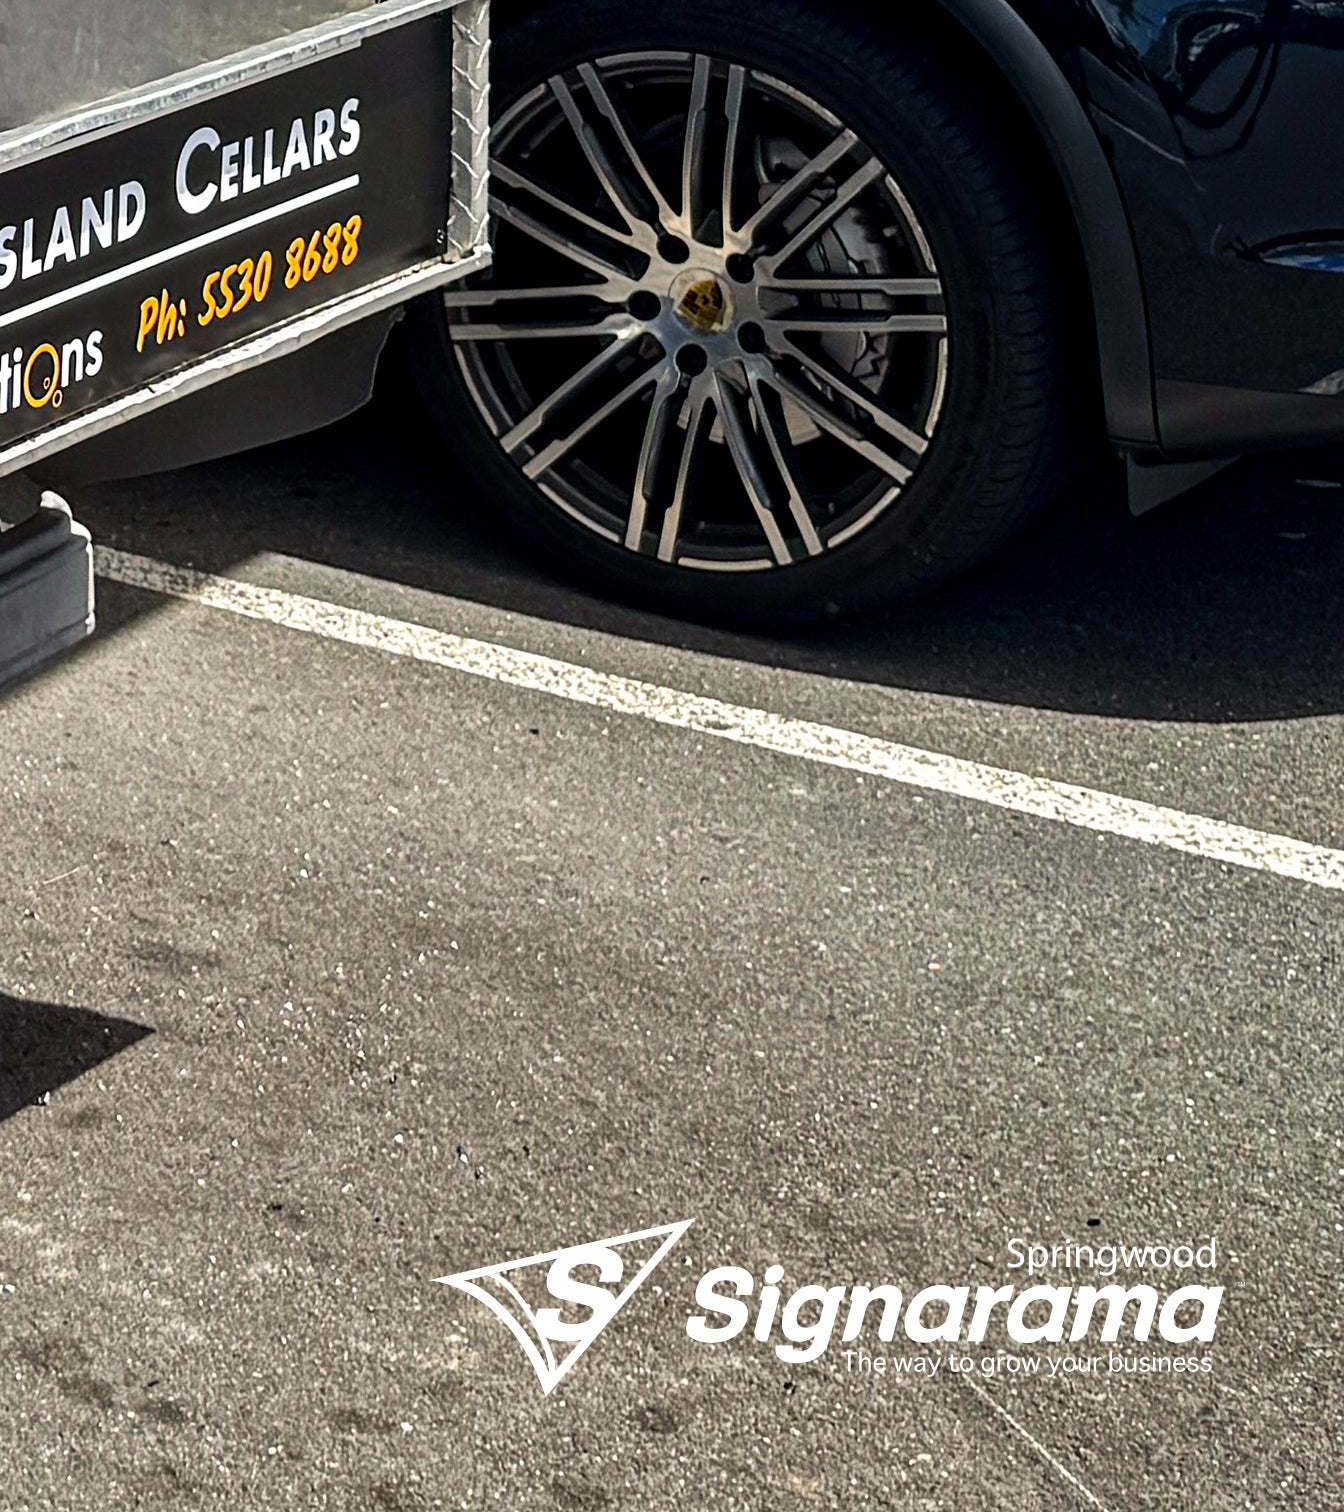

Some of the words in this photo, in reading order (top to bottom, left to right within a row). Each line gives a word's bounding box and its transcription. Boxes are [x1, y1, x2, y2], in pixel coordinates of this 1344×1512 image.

[175, 96, 362, 215] CELLARS
[136, 288, 188, 354] Ph:
[197, 249, 274, 327] 5530
[284, 214, 363, 292] 8688
